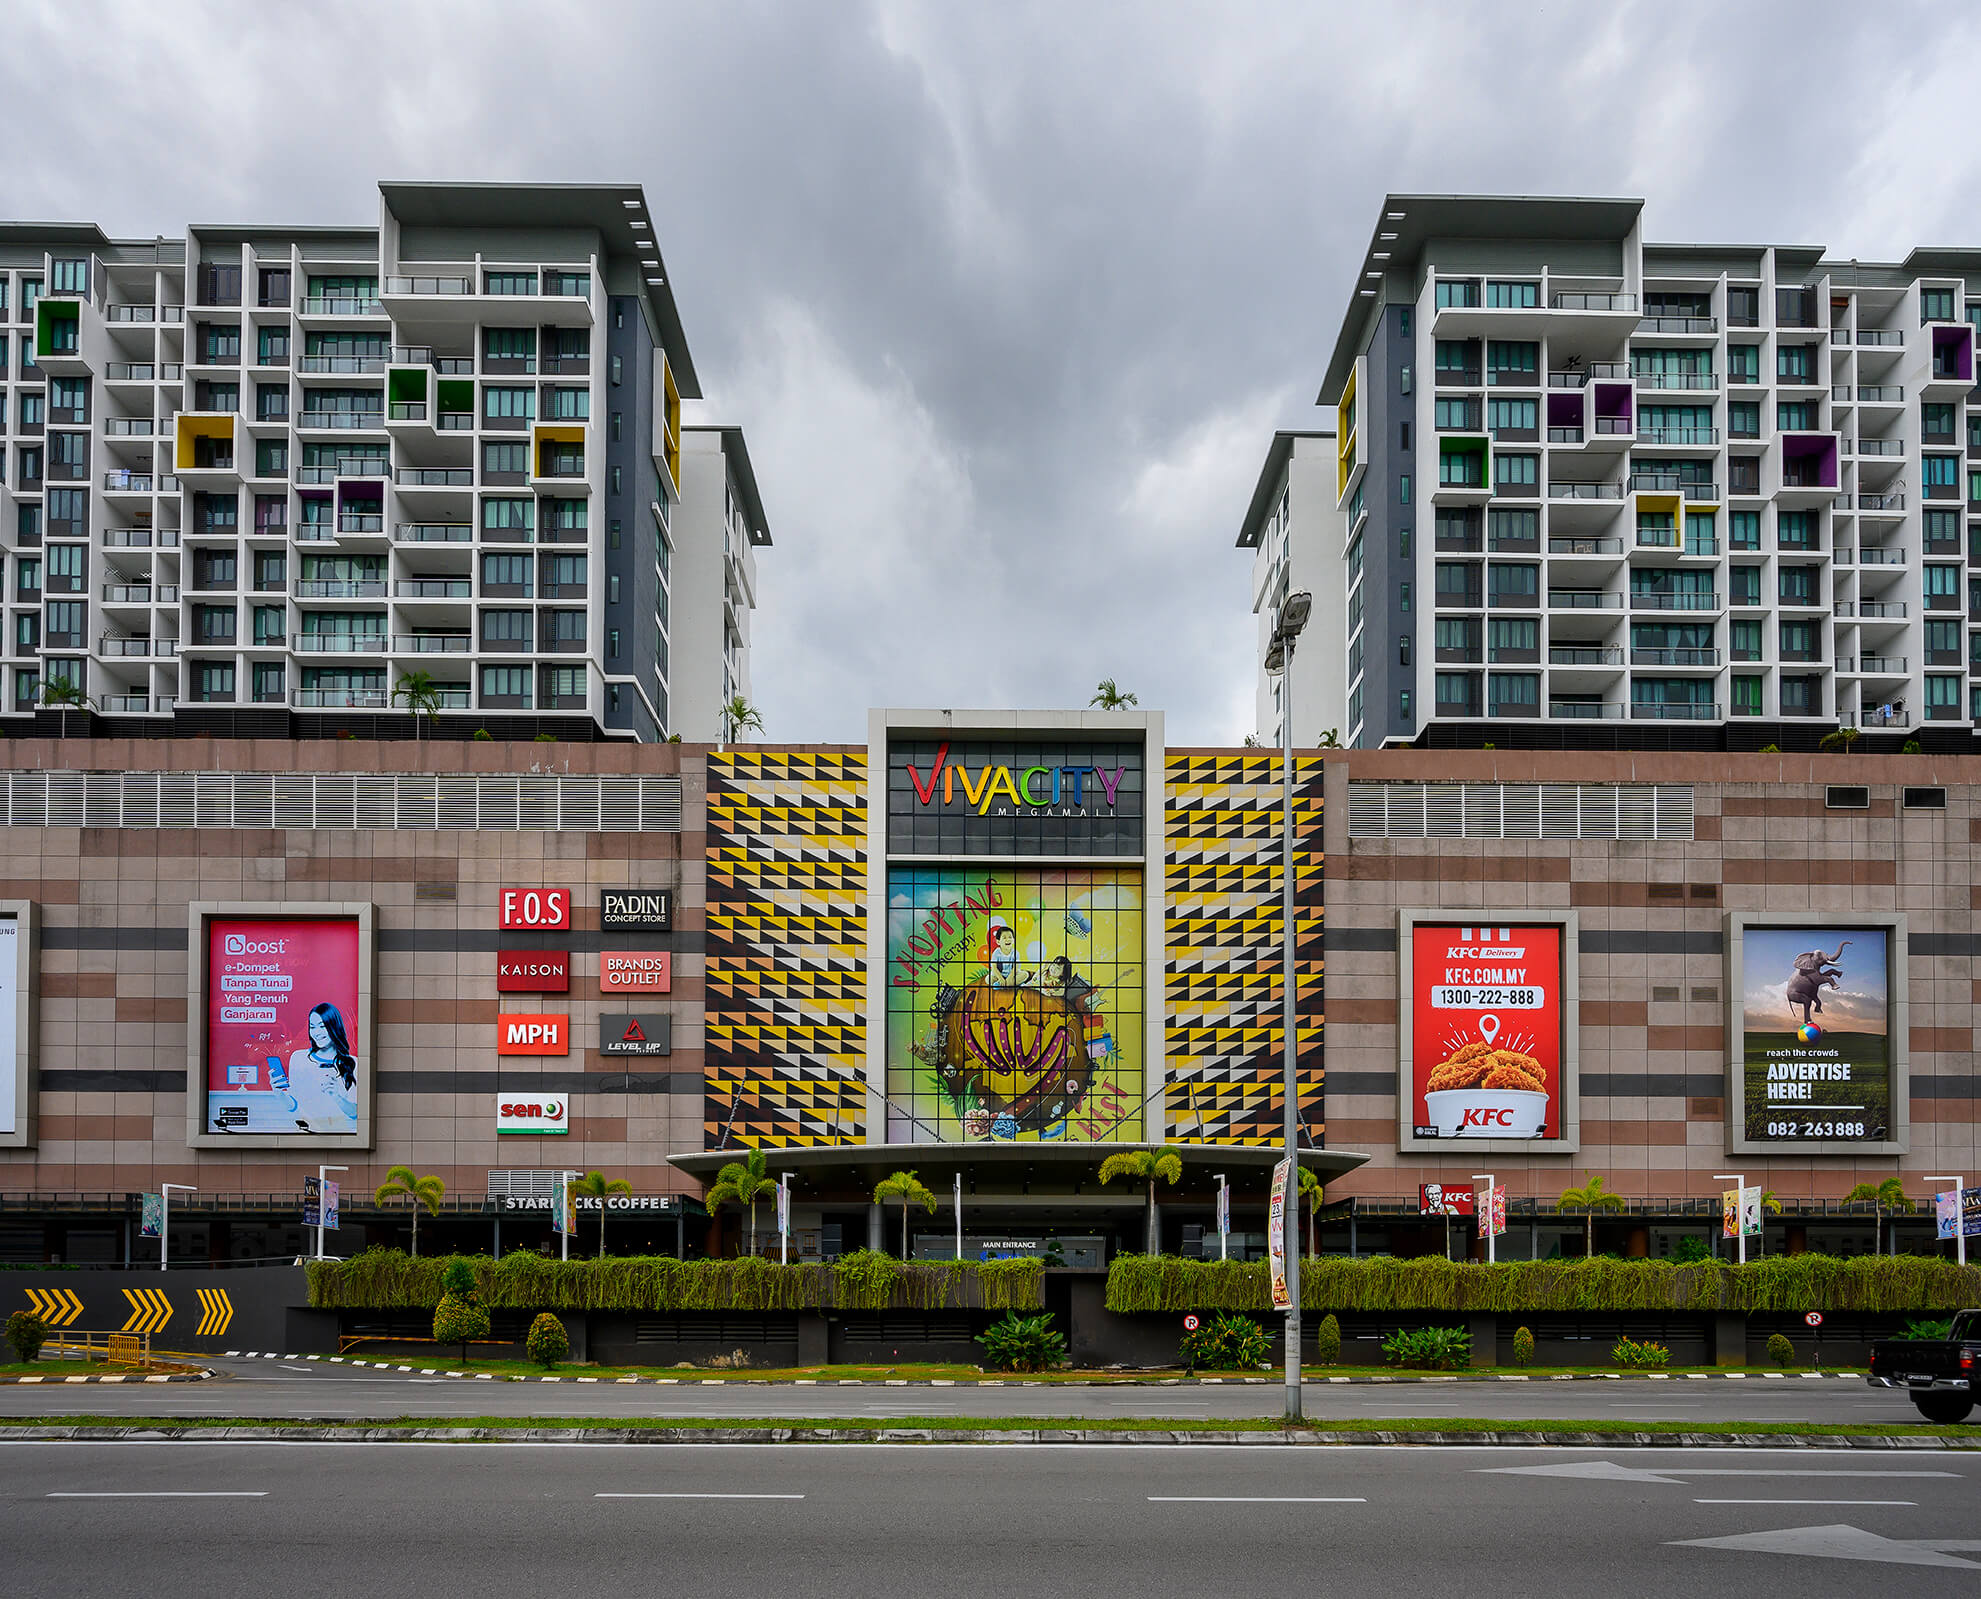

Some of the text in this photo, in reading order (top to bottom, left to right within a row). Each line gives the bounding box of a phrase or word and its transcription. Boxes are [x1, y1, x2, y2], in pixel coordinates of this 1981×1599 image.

[906, 742, 1126, 816] VIVACITY
[998, 807, 1115, 817] MEGAMALL
[504, 892, 563, 925] F.O.S
[604, 895, 666, 914] PADINI
[604, 914, 666, 923] CONCEPT STORE
[892, 878, 1003, 993] SHOPPING
[925, 930, 977, 976] Therapy
[1446, 947, 1518, 959] KFC Delivery
[224, 962, 280, 974] e-Dompet
[500, 964, 563, 976] KAISON
[607, 958, 663, 971] BRANDS
[609, 972, 661, 985] OUTLET
[1445, 968, 1526, 984] KFC.COM.MY
[224, 978, 289, 989] Tanpa Tunai
[224, 993, 288, 1005] Yang Penuh
[1441, 989, 1534, 1005] 1300-222-888
[224, 1009, 273, 1021] Ganjaran
[507, 1024, 558, 1044] MPH
[607, 1042, 642, 1051] LEVEL
[646, 1042, 661, 1051] UP
[1766, 1049, 1839, 1057] reach the crowds
[1766, 1063, 1851, 1081] ADVERTISE
[1767, 1082, 1812, 1099] HERE!
[1076, 1076, 1128, 1140] BEST
[1461, 1108, 1514, 1126] KFC
[1767, 1121, 1797, 1136] 082
[506, 1197, 669, 1210] STARCKS COFFEE
[1444, 1192, 1472, 1202] KFC
[982, 1241, 1037, 1249] MAIN ENTRANCE
